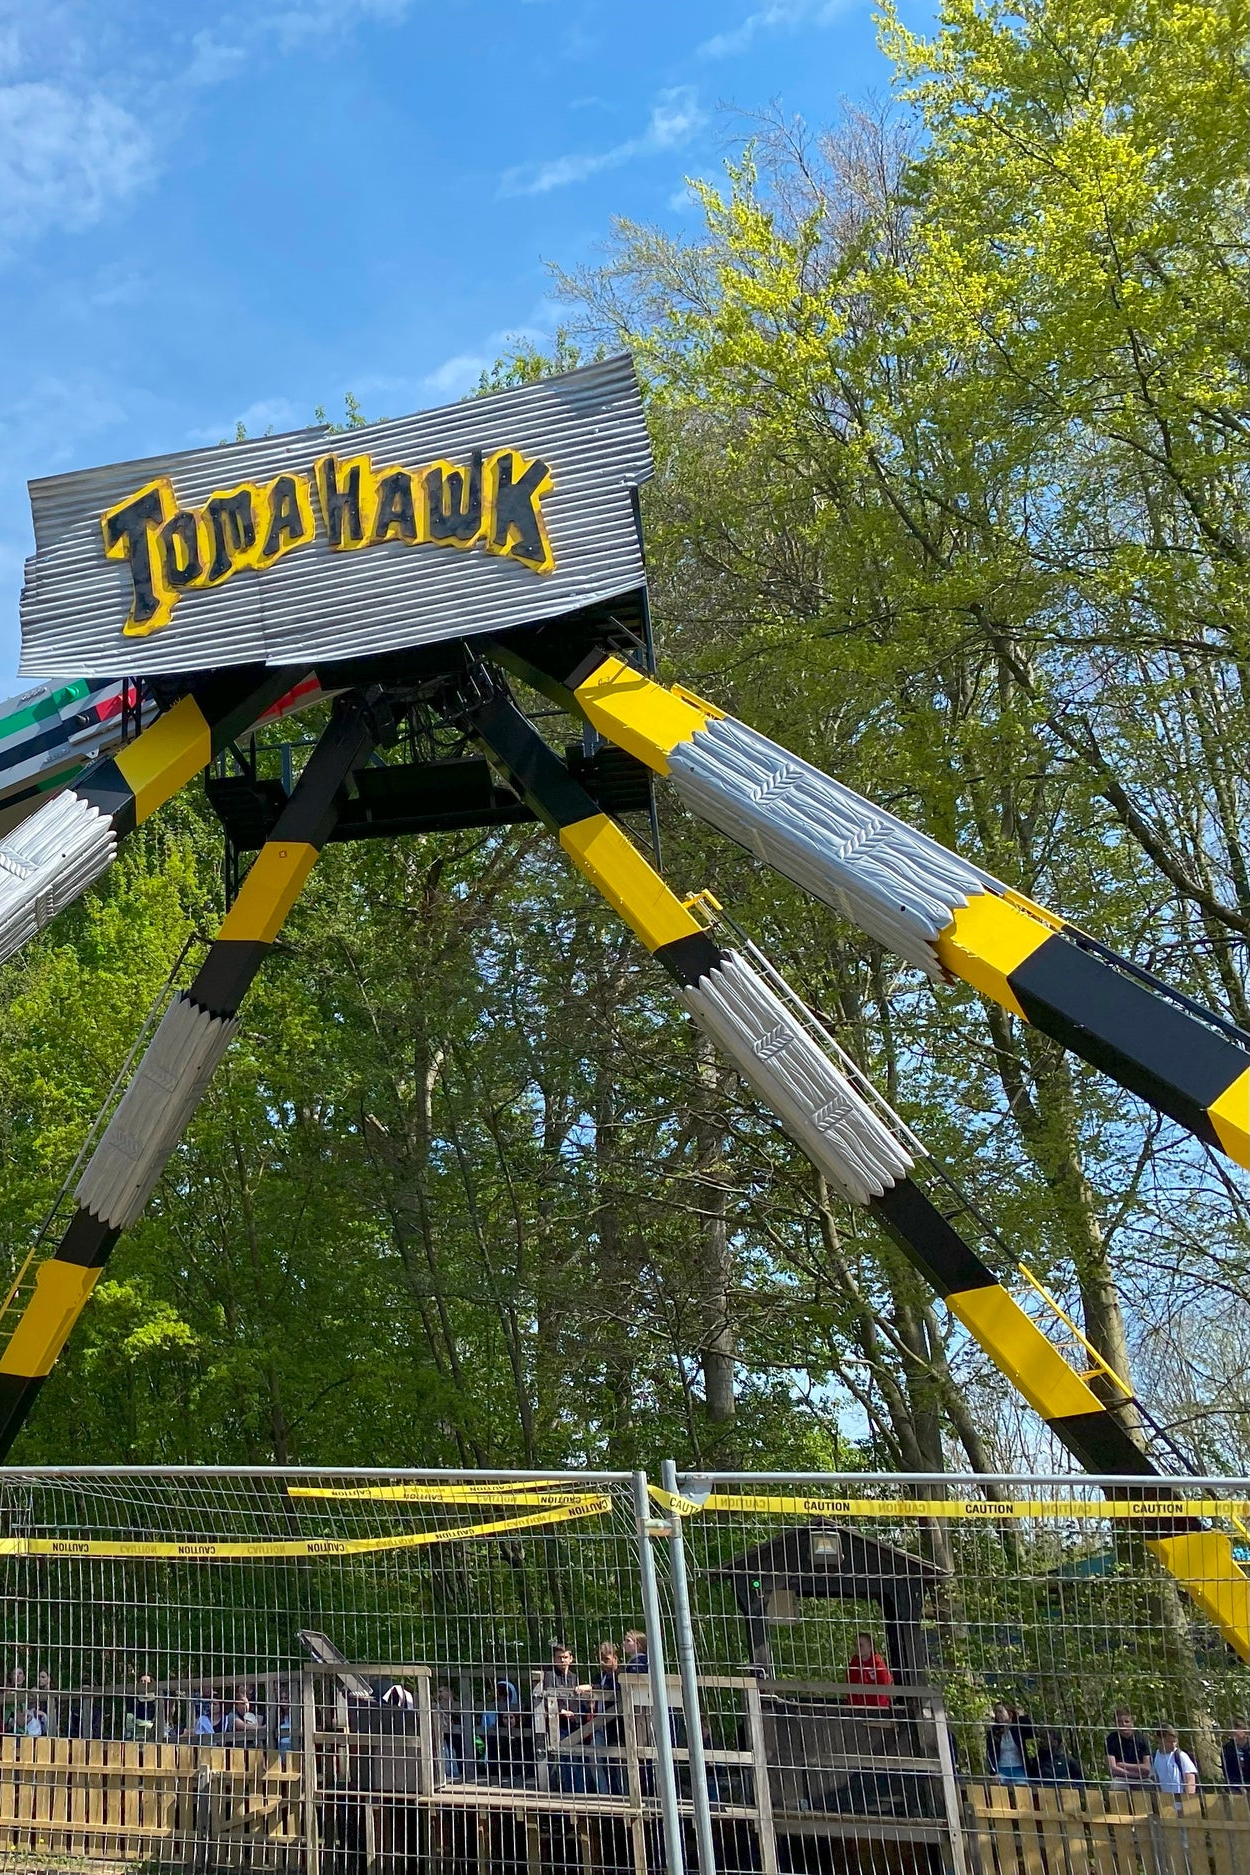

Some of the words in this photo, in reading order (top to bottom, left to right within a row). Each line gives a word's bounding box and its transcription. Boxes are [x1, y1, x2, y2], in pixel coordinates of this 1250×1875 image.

[101, 448, 555, 635] TOMAHAWK
[540, 1496, 581, 1505] CAUTION
[568, 1499, 609, 1516] CAUTION
[803, 1501, 850, 1511] CAUTION
[965, 1504, 1014, 1514] CAUTION
[1132, 1504, 1183, 1514] CAUTION
[435, 1528, 475, 1540] CAUTION
[52, 1542, 89, 1553] CAUTION
[178, 1546, 216, 1555] CAUTION
[307, 1543, 345, 1553] CAUTION
